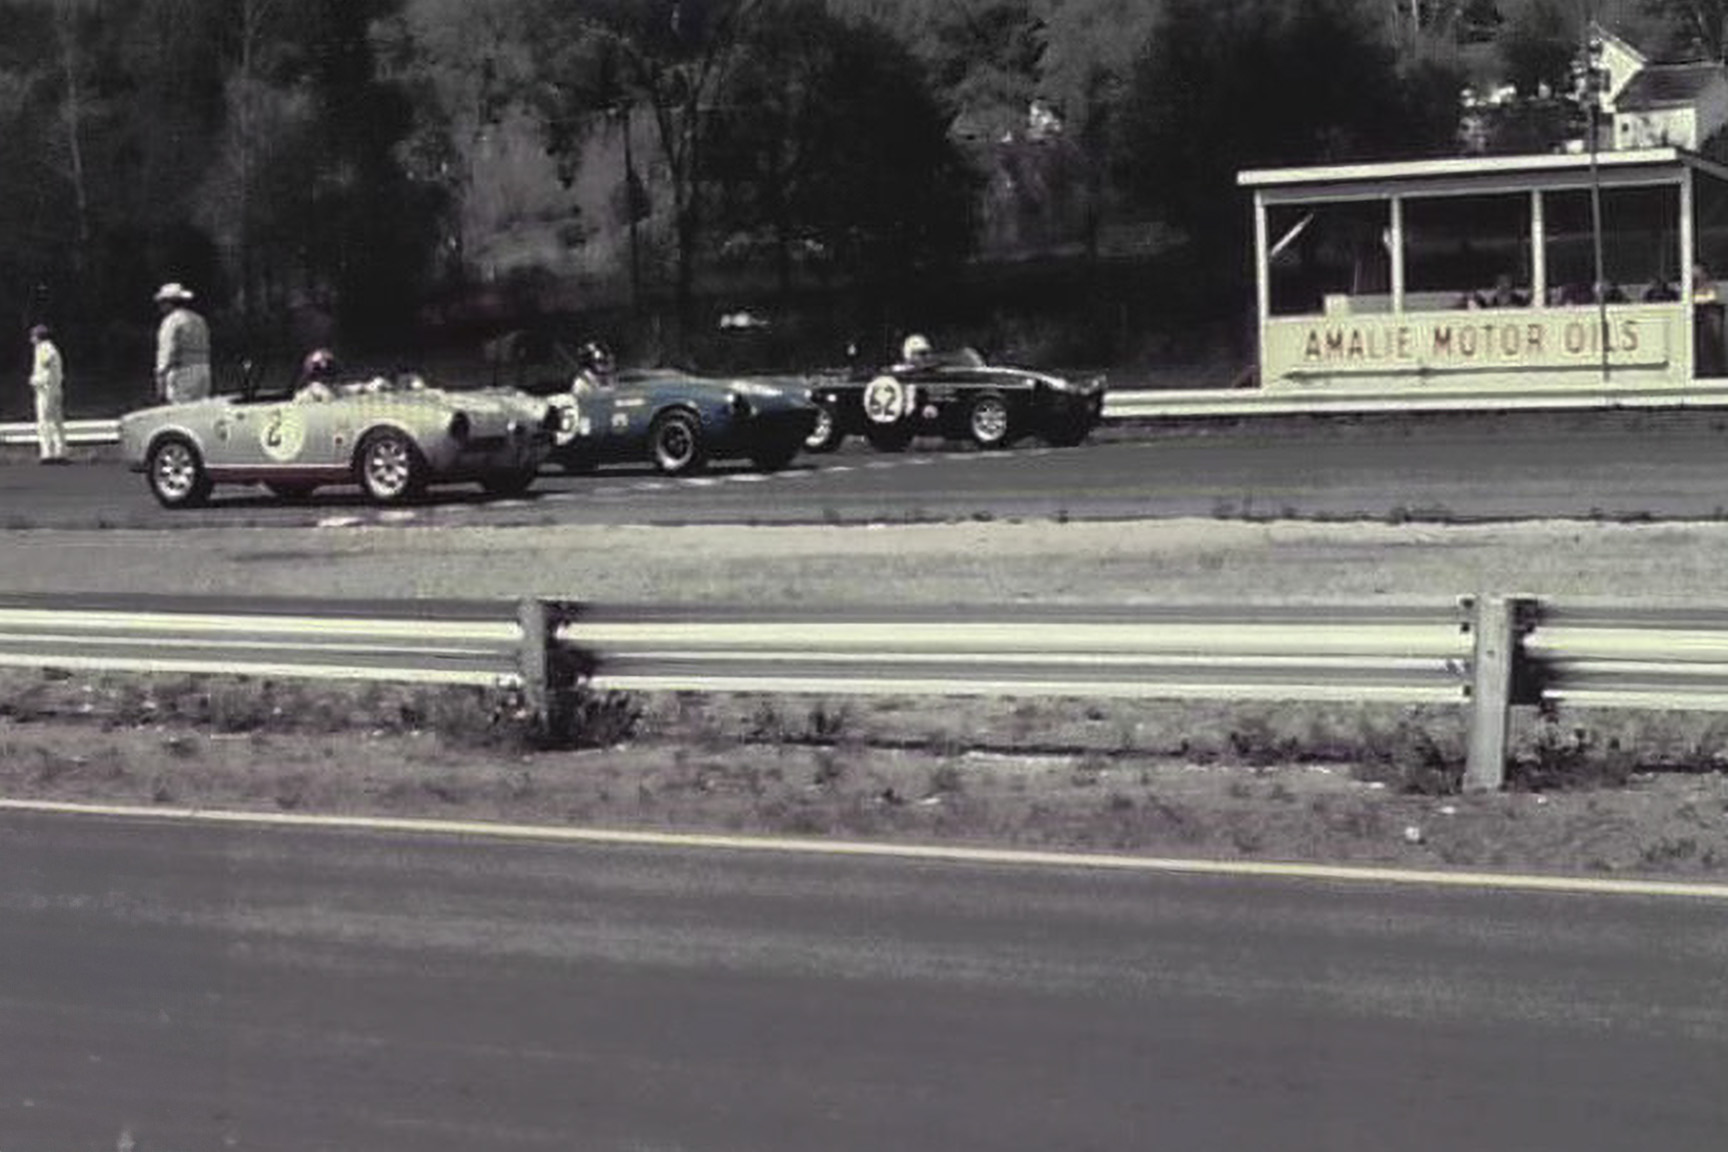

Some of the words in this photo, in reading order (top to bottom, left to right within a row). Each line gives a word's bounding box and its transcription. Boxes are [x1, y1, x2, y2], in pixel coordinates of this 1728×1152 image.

[1303, 326, 1414, 362] AMALIE
[1433, 322, 1543, 357] MOTOR
[1563, 319, 1640, 354] OILS
